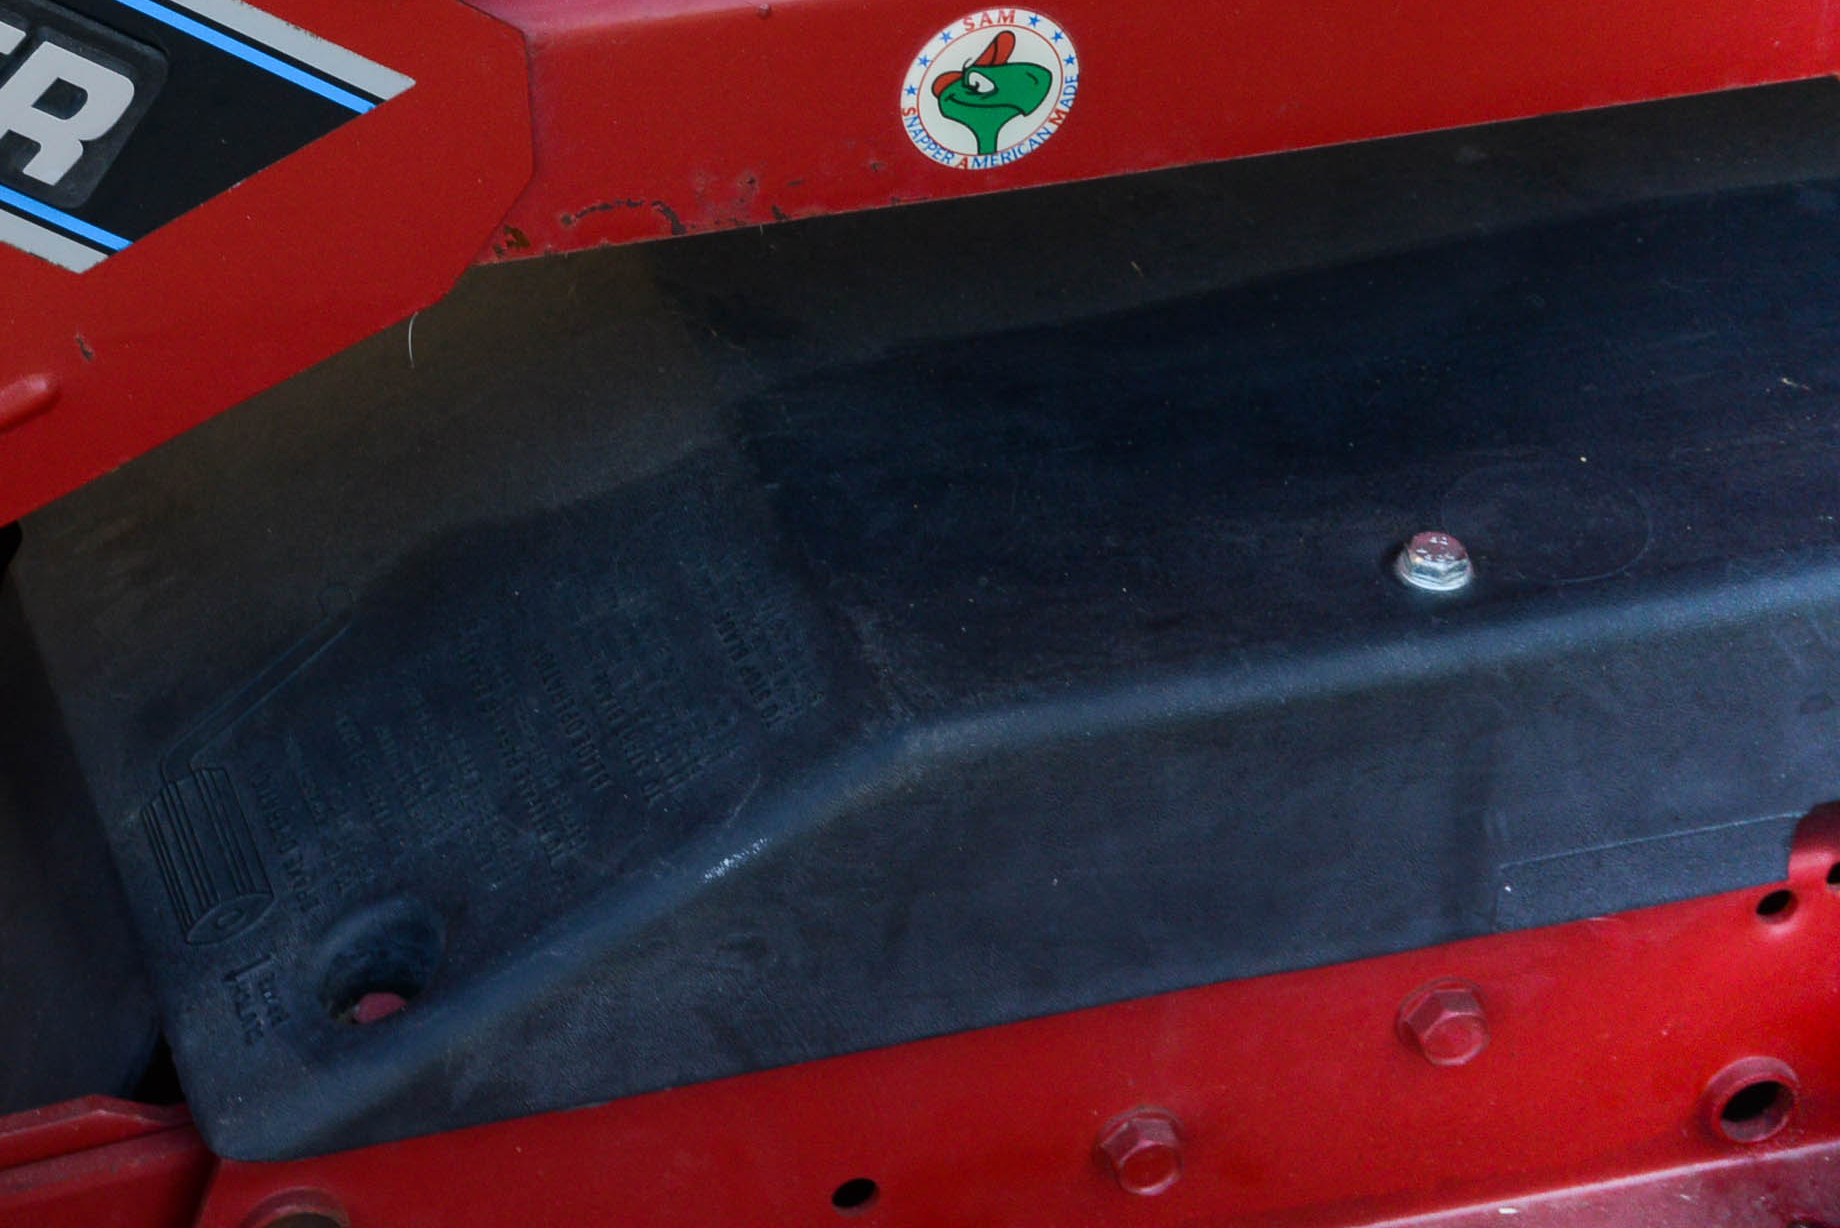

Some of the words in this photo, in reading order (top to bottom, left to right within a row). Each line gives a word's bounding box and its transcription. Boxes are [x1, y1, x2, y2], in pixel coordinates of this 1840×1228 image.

[963, 9, 1016, 32] SAM
[902, 106, 954, 165] SNAPPER
[957, 127, 1052, 170] AMERICAN
[1048, 74, 1080, 126] MADE
